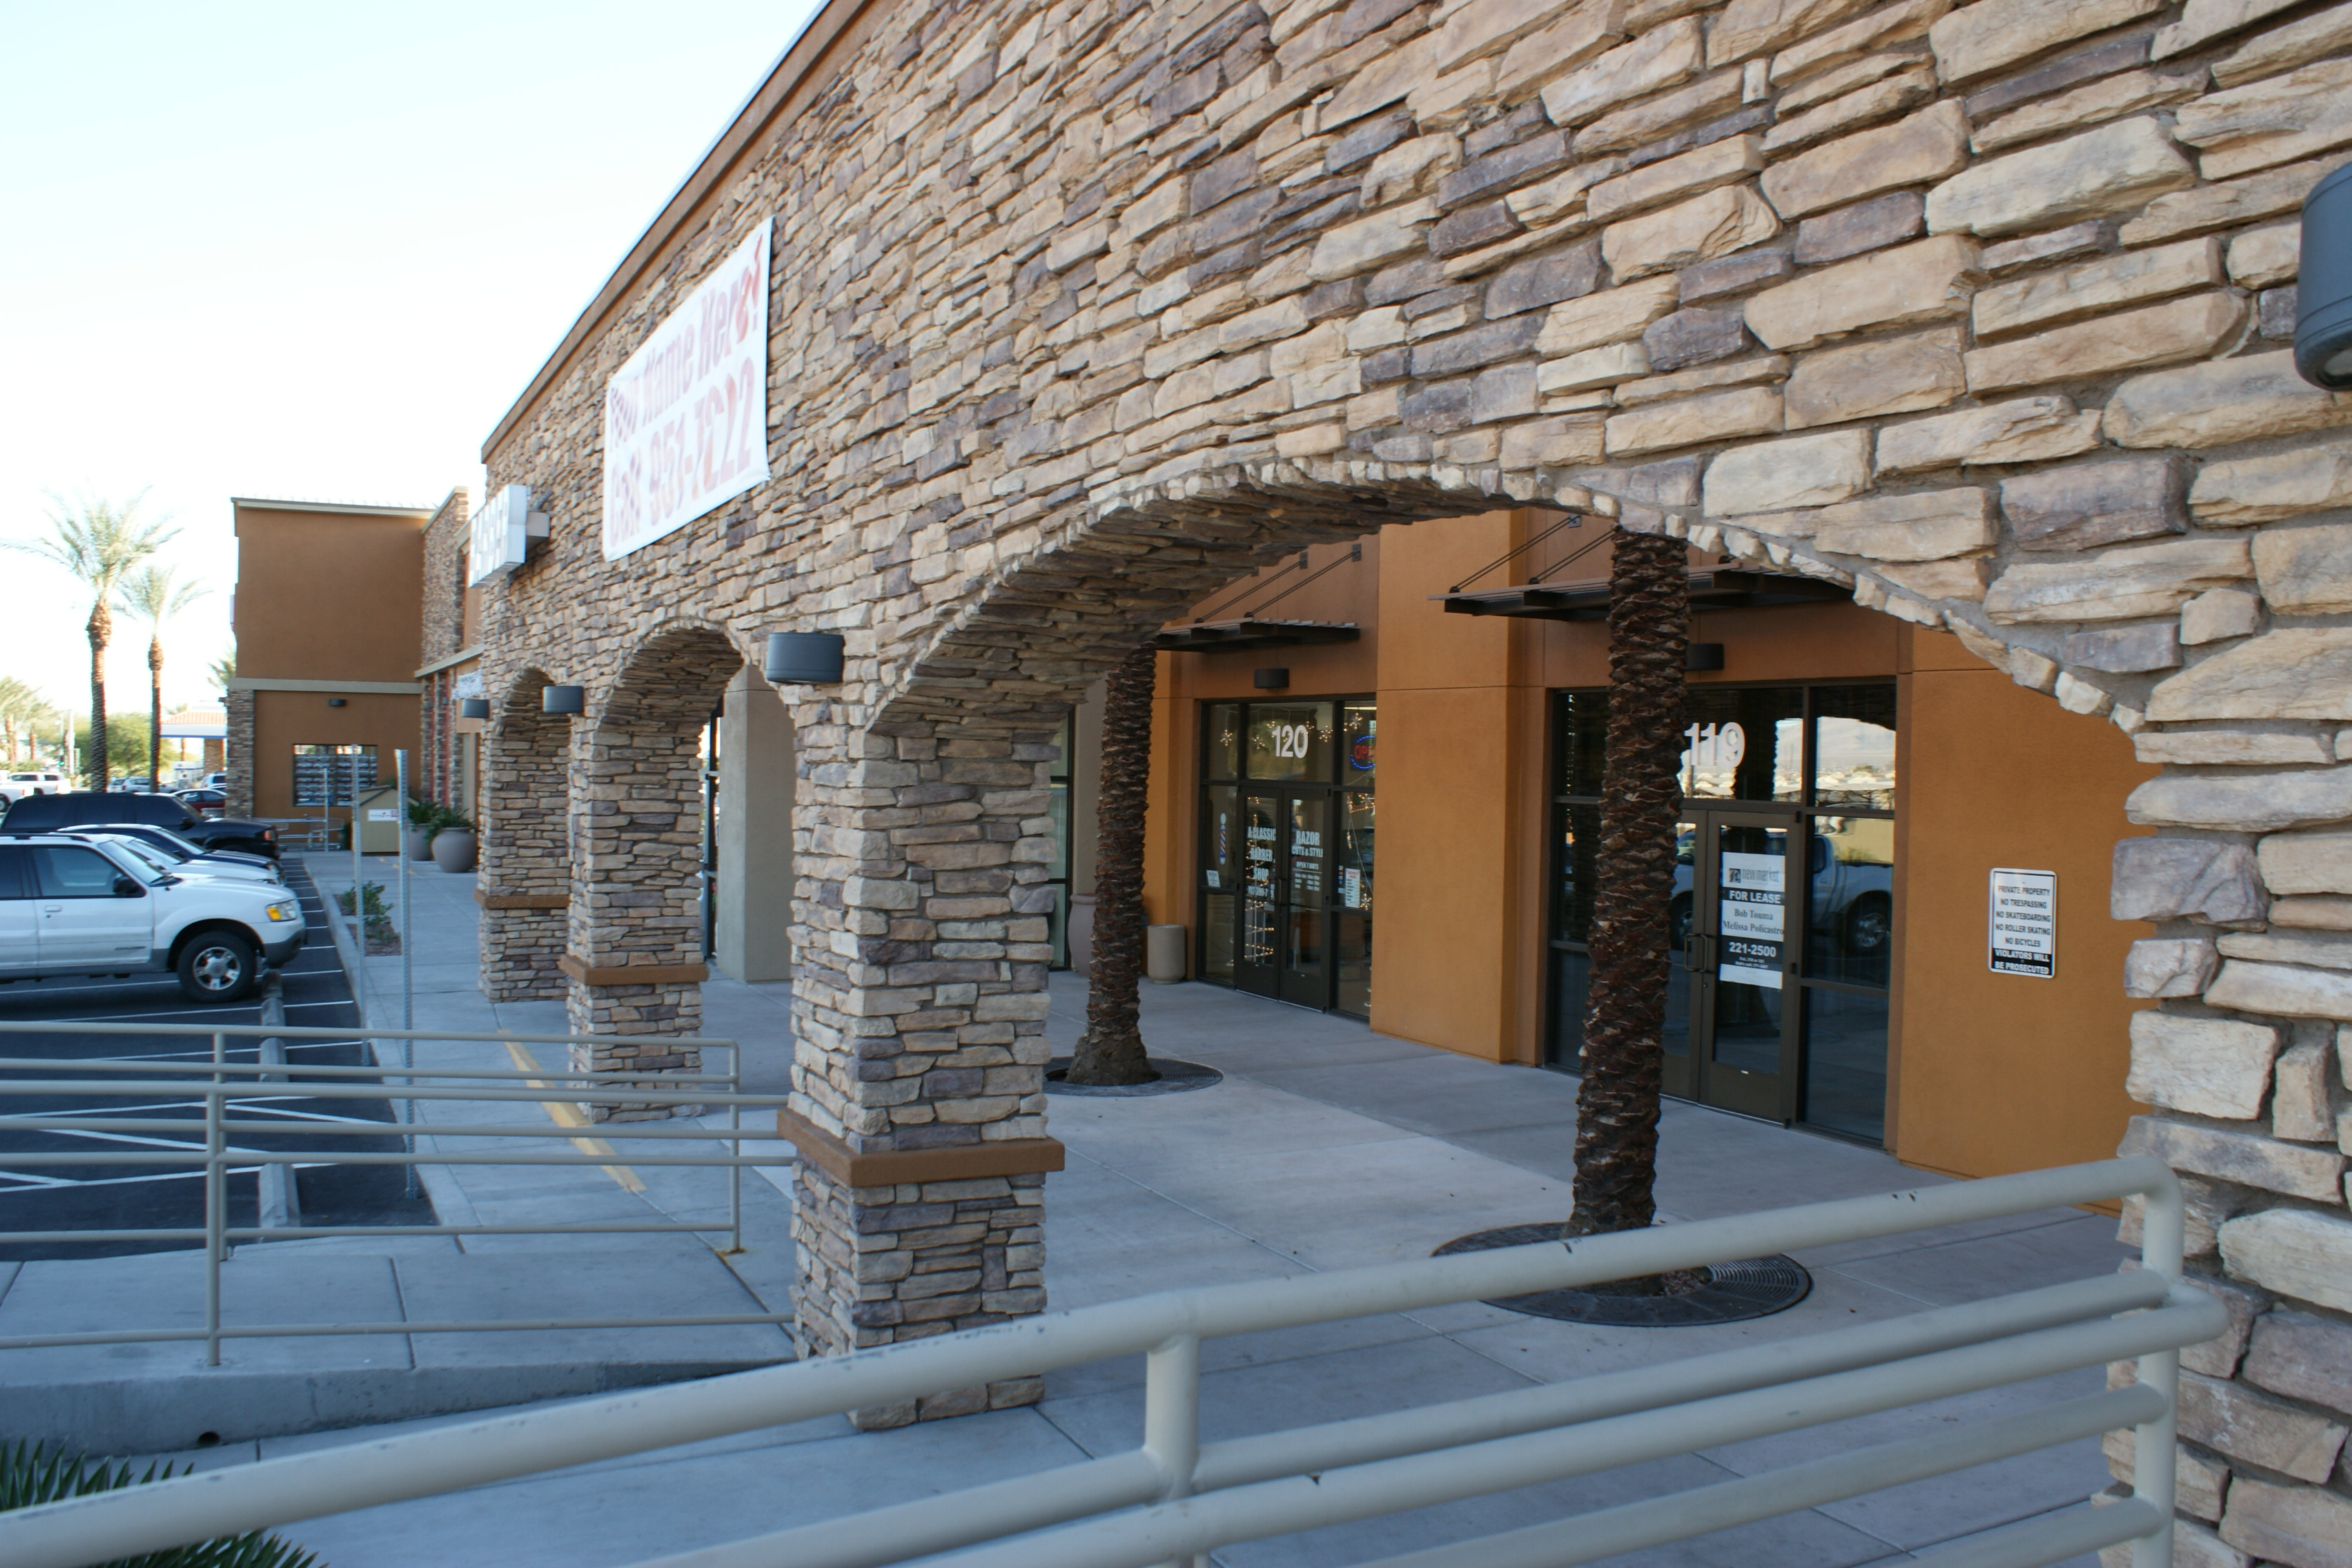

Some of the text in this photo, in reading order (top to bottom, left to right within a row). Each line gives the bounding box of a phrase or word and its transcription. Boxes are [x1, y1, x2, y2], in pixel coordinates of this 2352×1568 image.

[643, 323, 695, 424] Name
[697, 233, 762, 380] Here!
[649, 355, 755, 527] 951-7222
[1272, 725, 1309, 758] 120
[1684, 722, 1745, 767] 119
[1353, 745, 1376, 760] OPE
[1254, 827, 1276, 841] CLASSIC
[1295, 830, 1320, 845] RAZOR
[1251, 847, 1273, 862] BARBER
[1292, 845, 1305, 856] CUTS
[1305, 848, 1309, 856] &
[1253, 867, 1269, 880] SHOP
[1729, 890, 1781, 904] FOR LEASE
[1998, 885, 2050, 896] PRIVATE PROPERTY
[2010, 899, 2047, 909] TRESPASSING
[1734, 908, 1774, 920] Bob Touma
[2006, 912, 2051, 922] SKATEBOARDING
[1723, 920, 1785, 935] Melissa Policastro
[2005, 924, 2026, 933] ROLLER
[2027, 927, 2051, 935] SKATING
[1728, 941, 1776, 958] 221-2500
[2015, 938, 2041, 948] BICYCLES
[1995, 949, 2050, 962] VIOLATORS WILL
[1995, 961, 2050, 974] BE PROSECUTED
